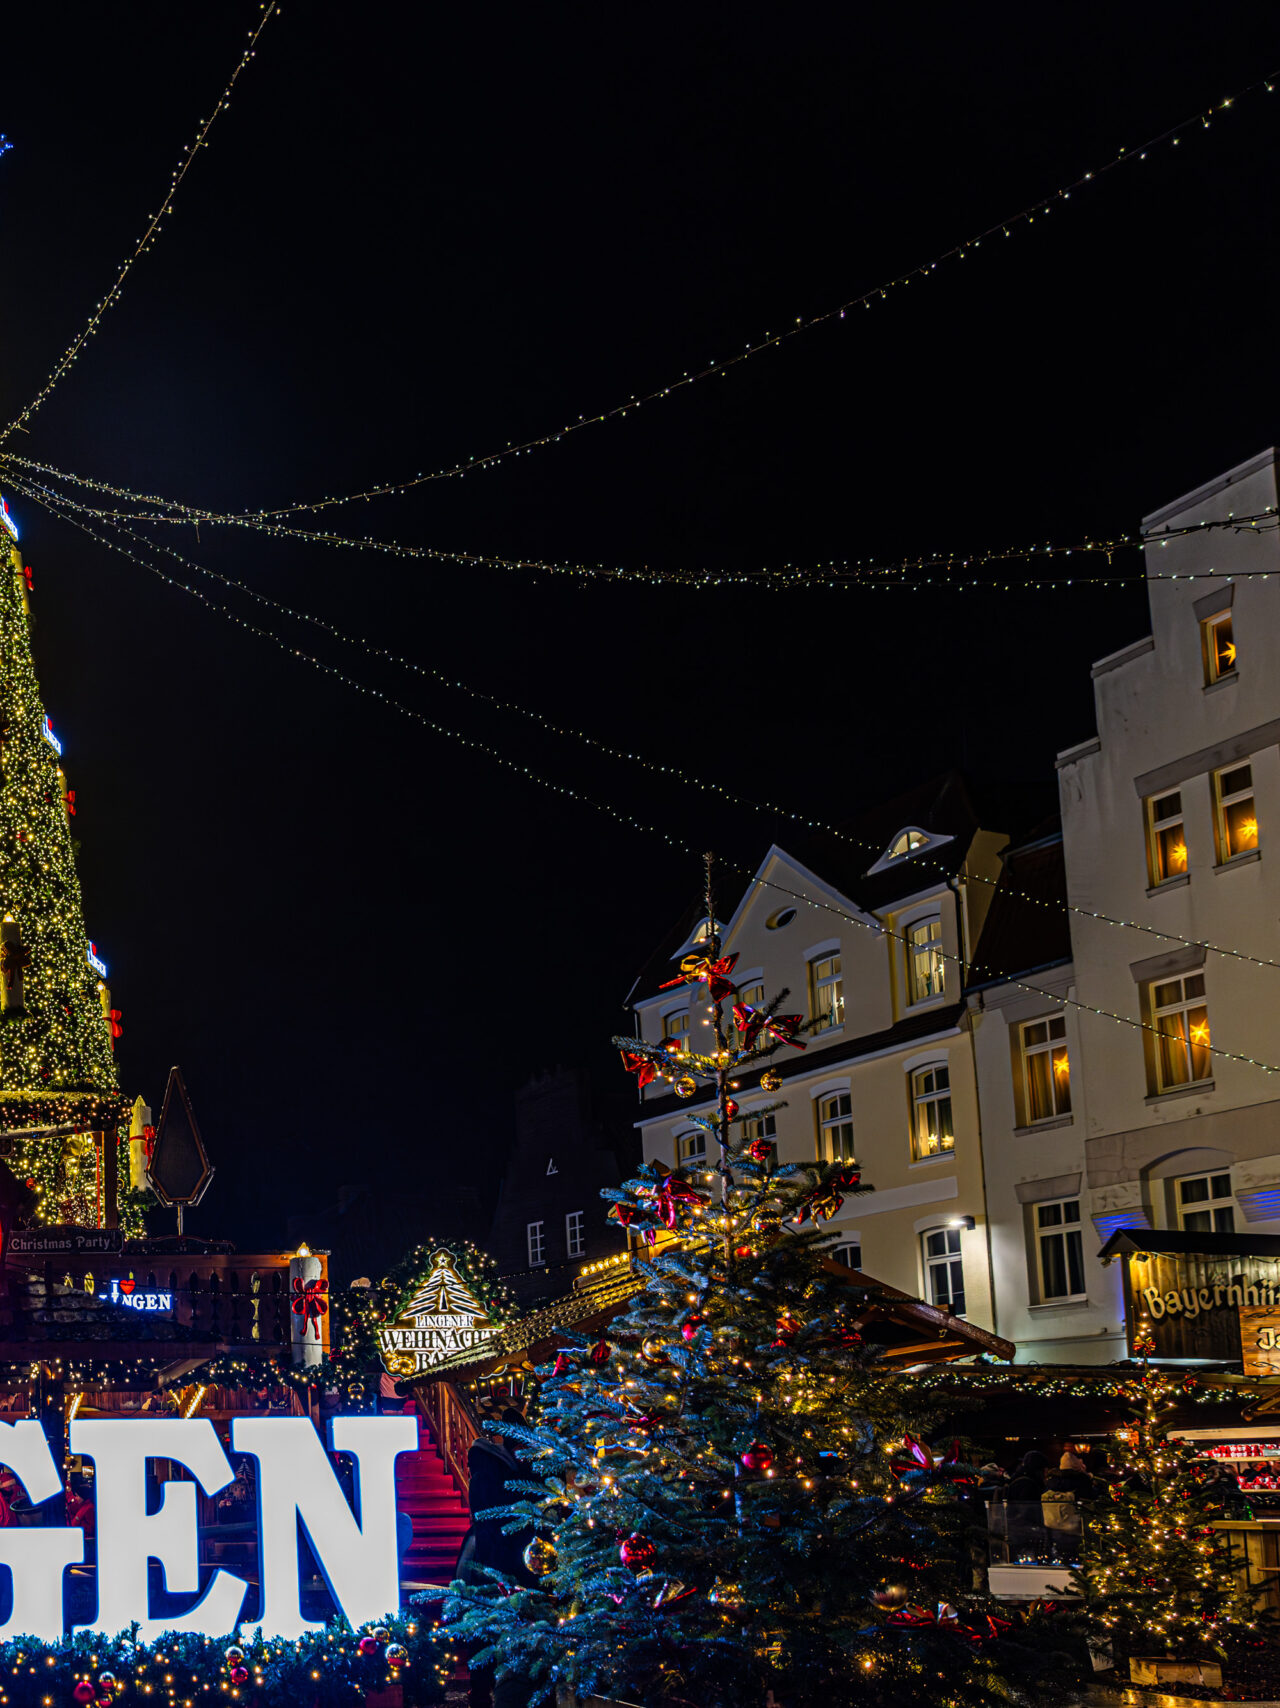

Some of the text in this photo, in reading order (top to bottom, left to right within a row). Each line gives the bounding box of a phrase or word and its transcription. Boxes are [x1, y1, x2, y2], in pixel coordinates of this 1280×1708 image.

[10, 1235, 111, 1250] Christmas Party
[111, 1280, 119, 1295] I
[415, 1315, 474, 1328] LINGENER
